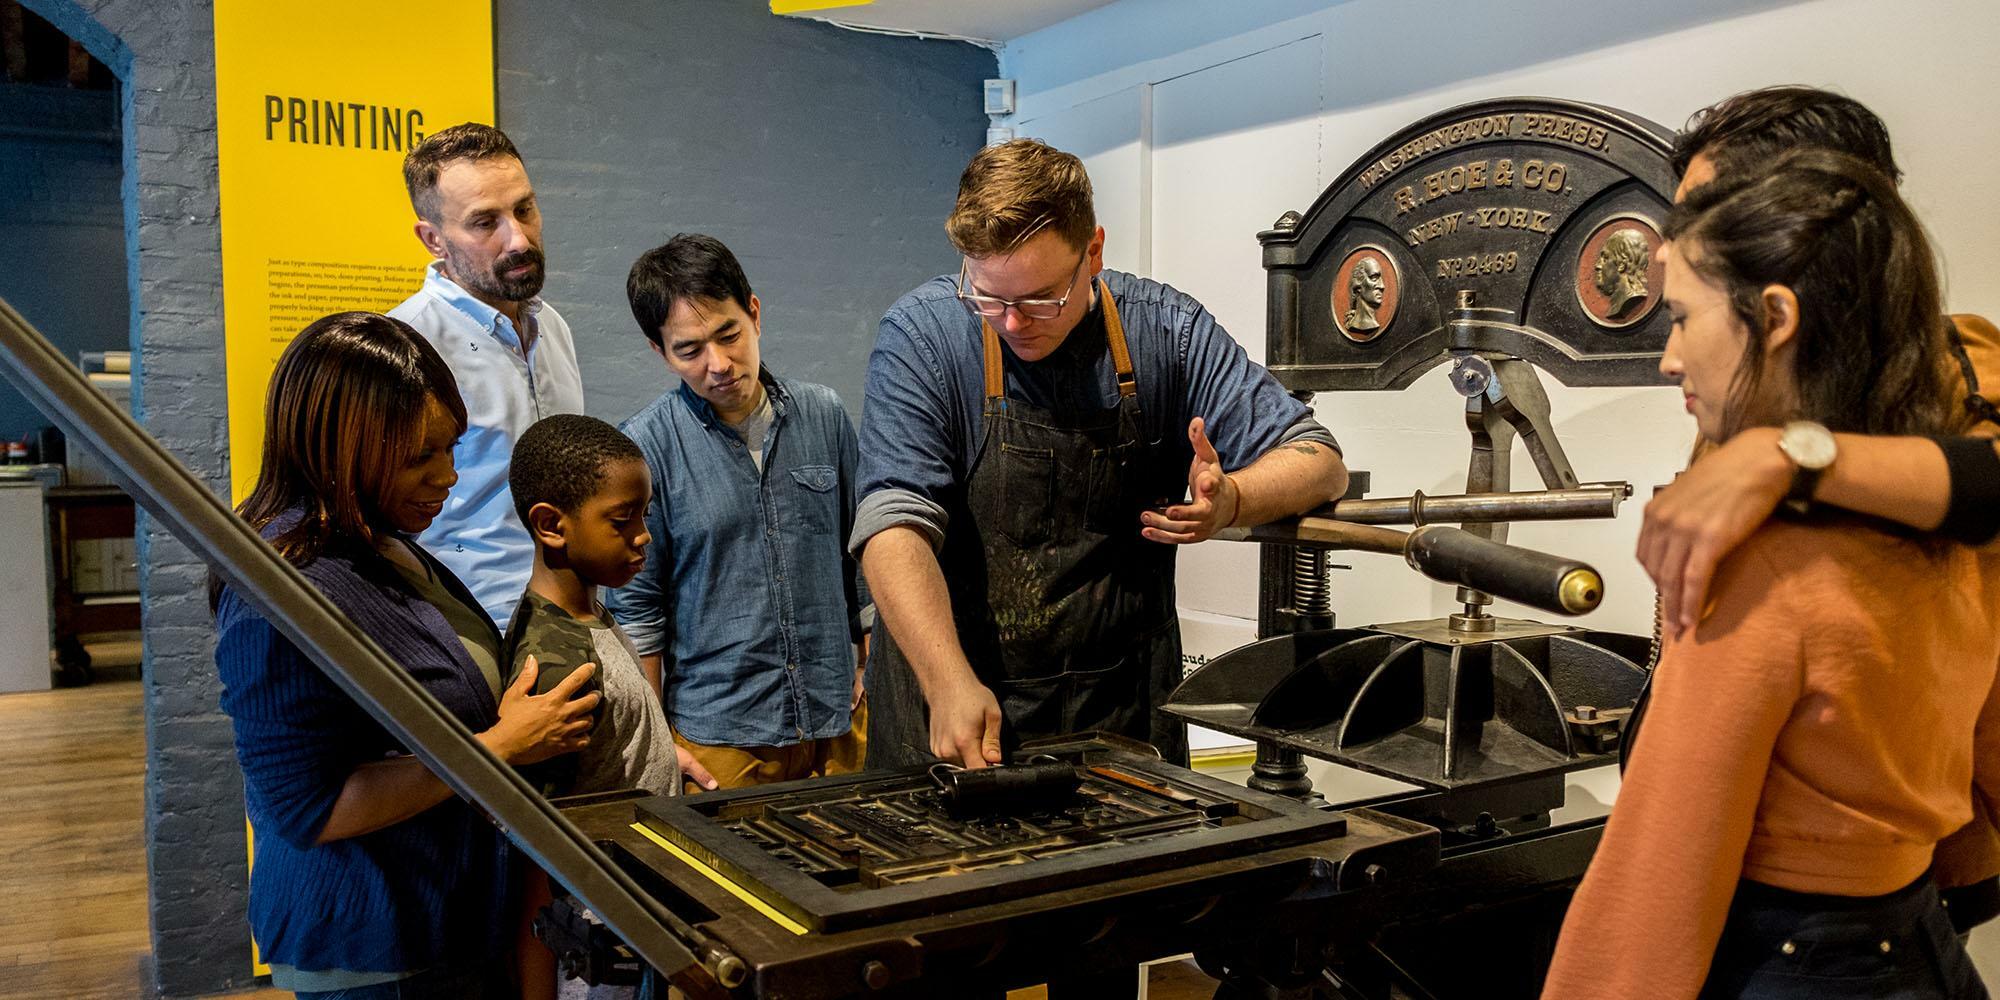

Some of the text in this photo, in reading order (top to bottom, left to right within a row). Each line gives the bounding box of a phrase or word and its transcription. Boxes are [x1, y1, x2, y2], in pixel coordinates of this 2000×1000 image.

[265, 95, 424, 152] PRINTING
[1358, 113, 1611, 190] WASHINGTON PRESS.
[1494, 160, 1515, 187] &
[267, 258, 281, 266] Just
[291, 260, 306, 268] type
[383, 264, 406, 272] specific
[270, 304, 298, 312] properly
[300, 304, 324, 312] locking
